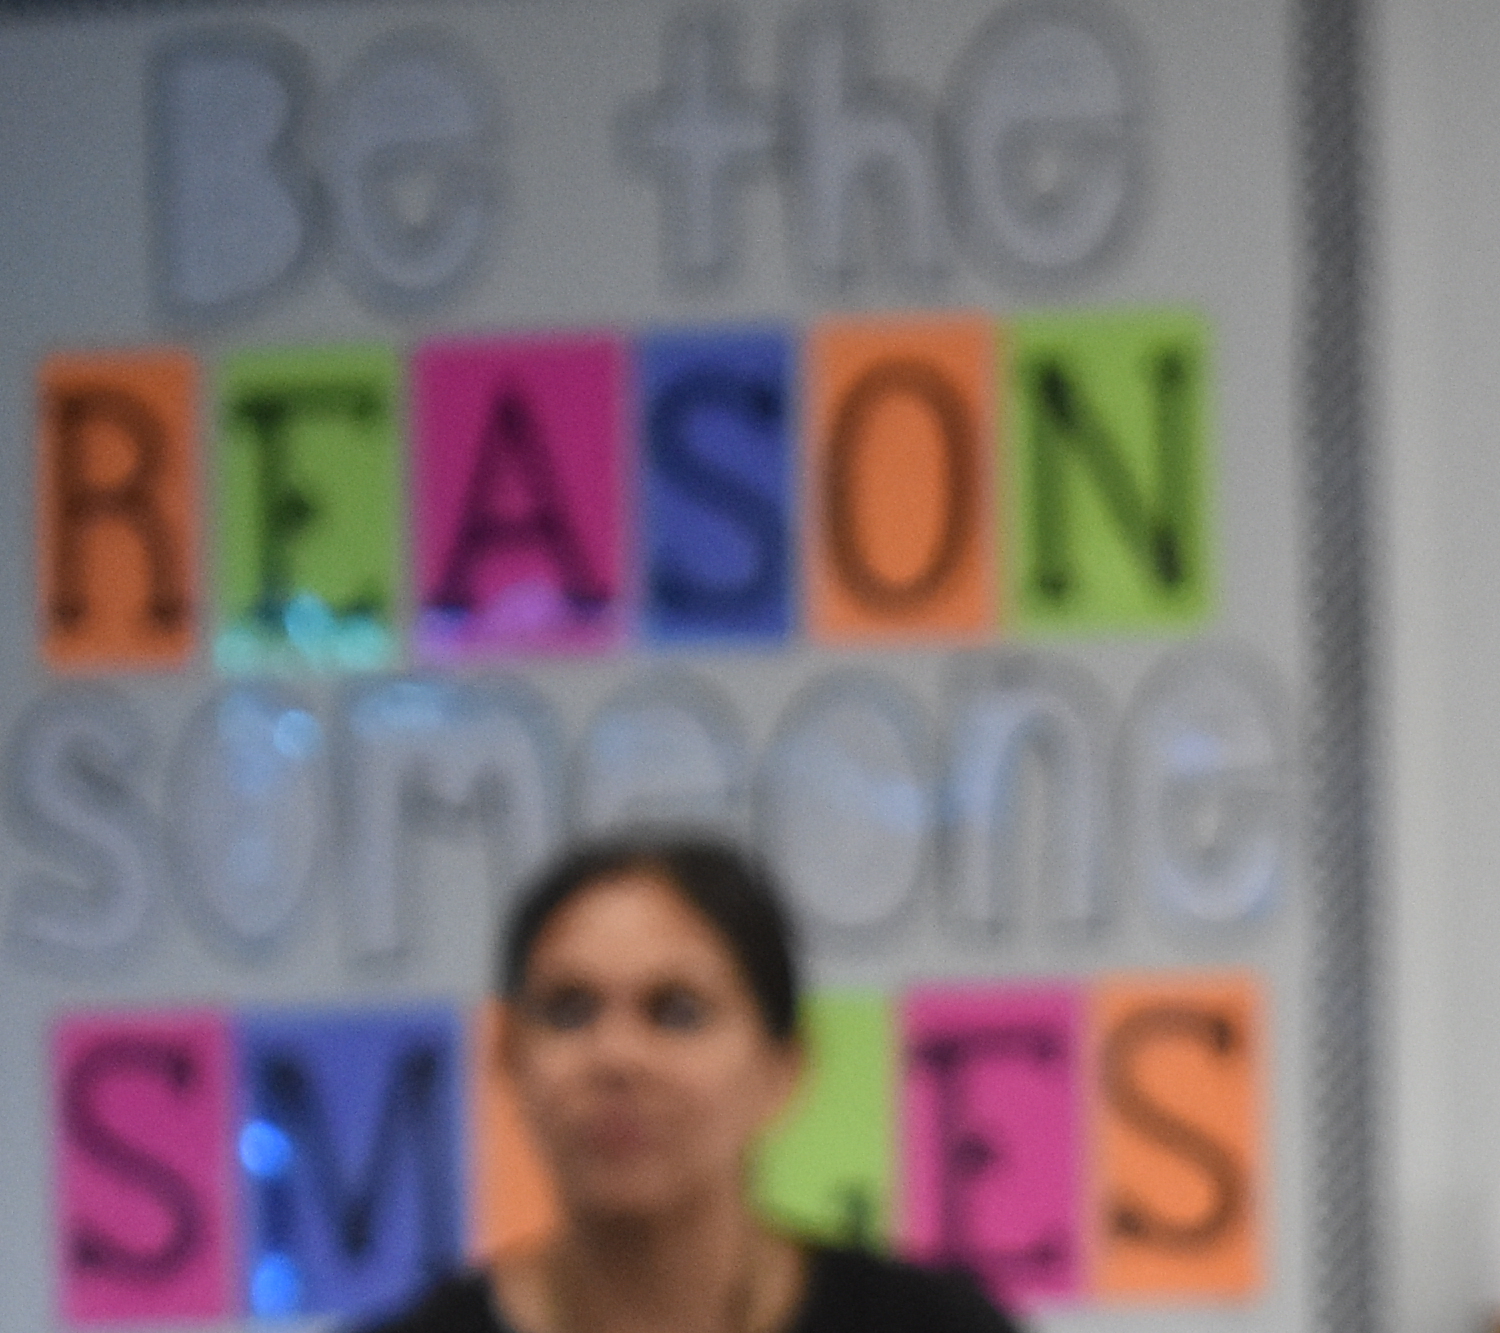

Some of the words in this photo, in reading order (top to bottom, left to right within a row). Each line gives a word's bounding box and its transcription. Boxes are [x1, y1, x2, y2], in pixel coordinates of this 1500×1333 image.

[146, 20, 512, 325] Be
[616, 0, 1150, 300] the
[50, 343, 1196, 638] REASON
[62, 1004, 1250, 1300] SMES
